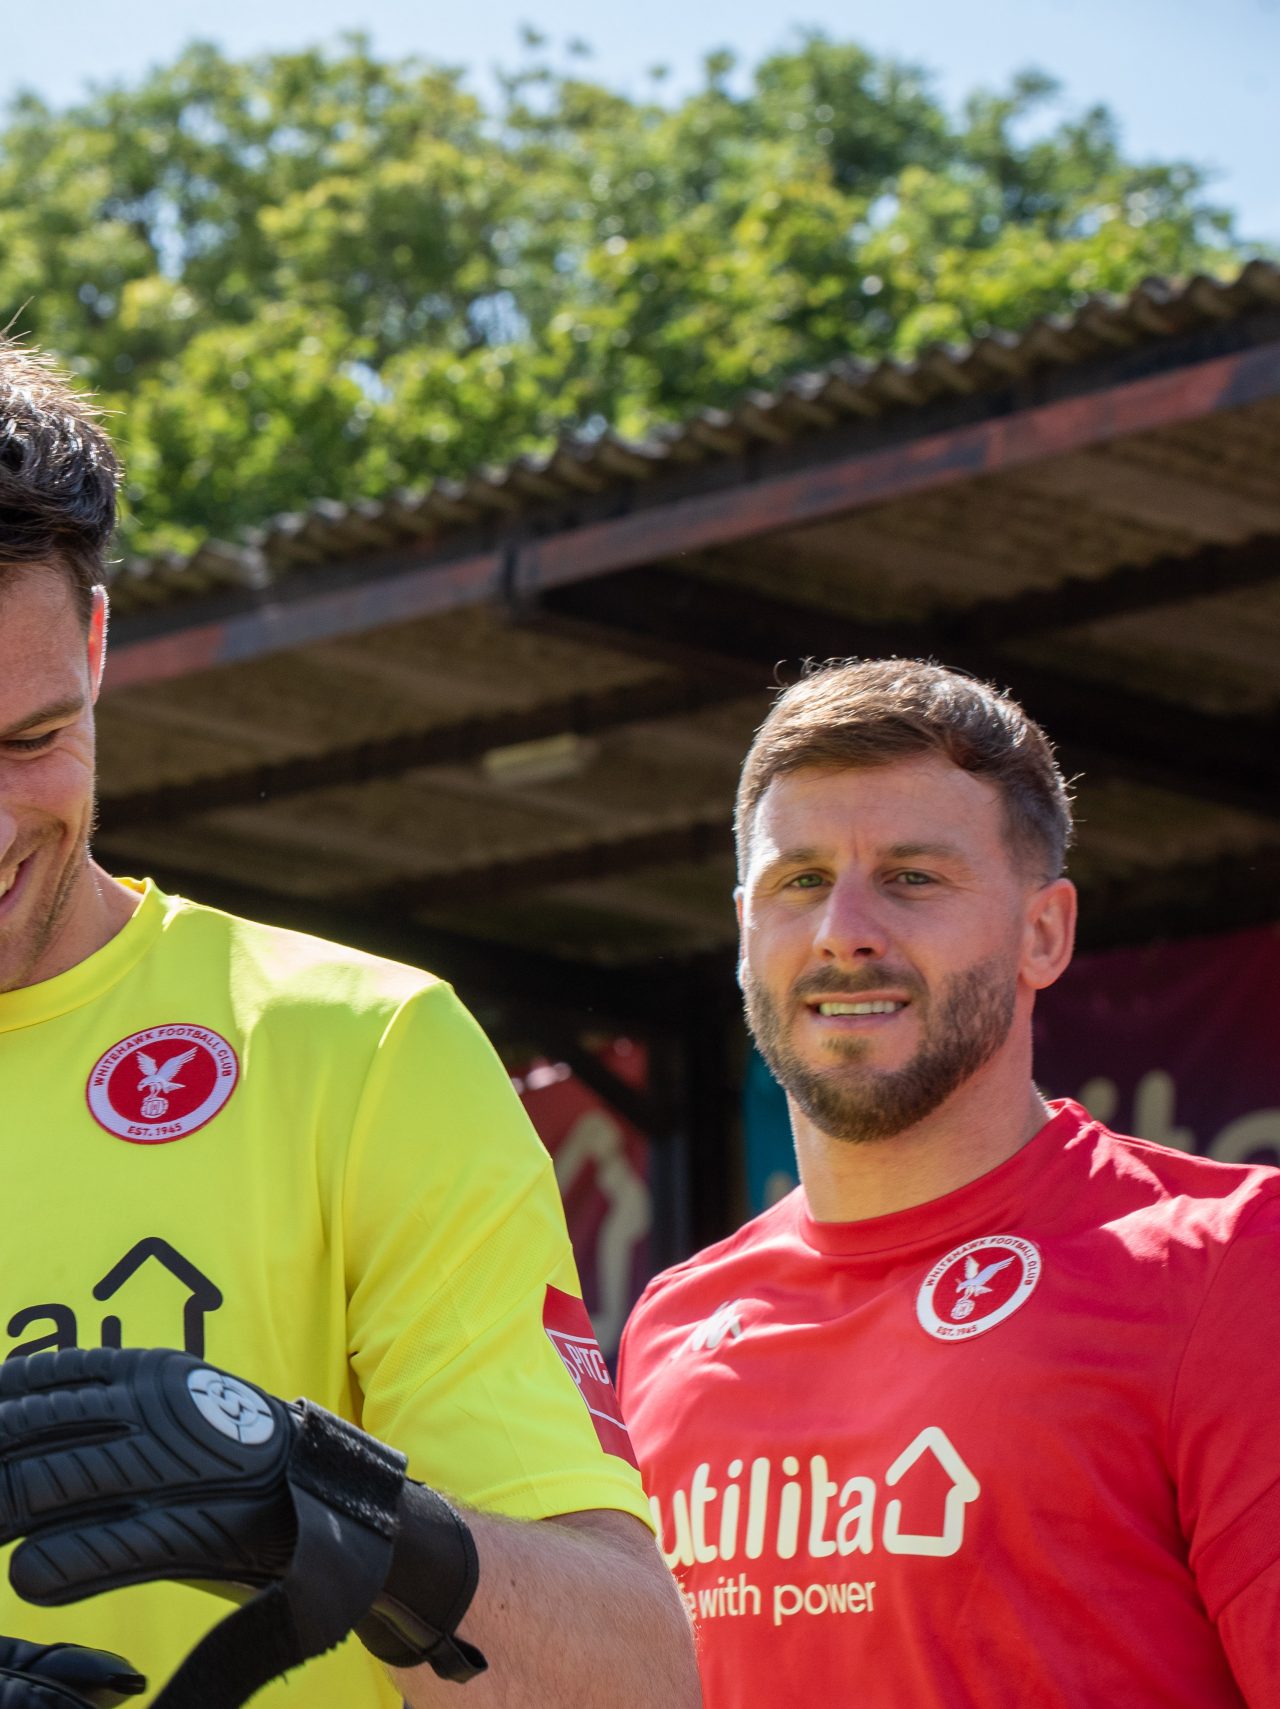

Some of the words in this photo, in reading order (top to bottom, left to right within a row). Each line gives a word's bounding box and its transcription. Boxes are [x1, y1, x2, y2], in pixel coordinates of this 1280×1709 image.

[94, 1031, 155, 1086] WHITEHAWK
[157, 1028, 221, 1050] FOOTBALL
[217, 1050, 233, 1077] CLUB
[127, 1126, 152, 1137] EST.
[155, 1123, 182, 1136] 1945
[650, 1455, 876, 1569] utilita
[698, 1572, 761, 1619] with
[773, 1580, 876, 1627] power
